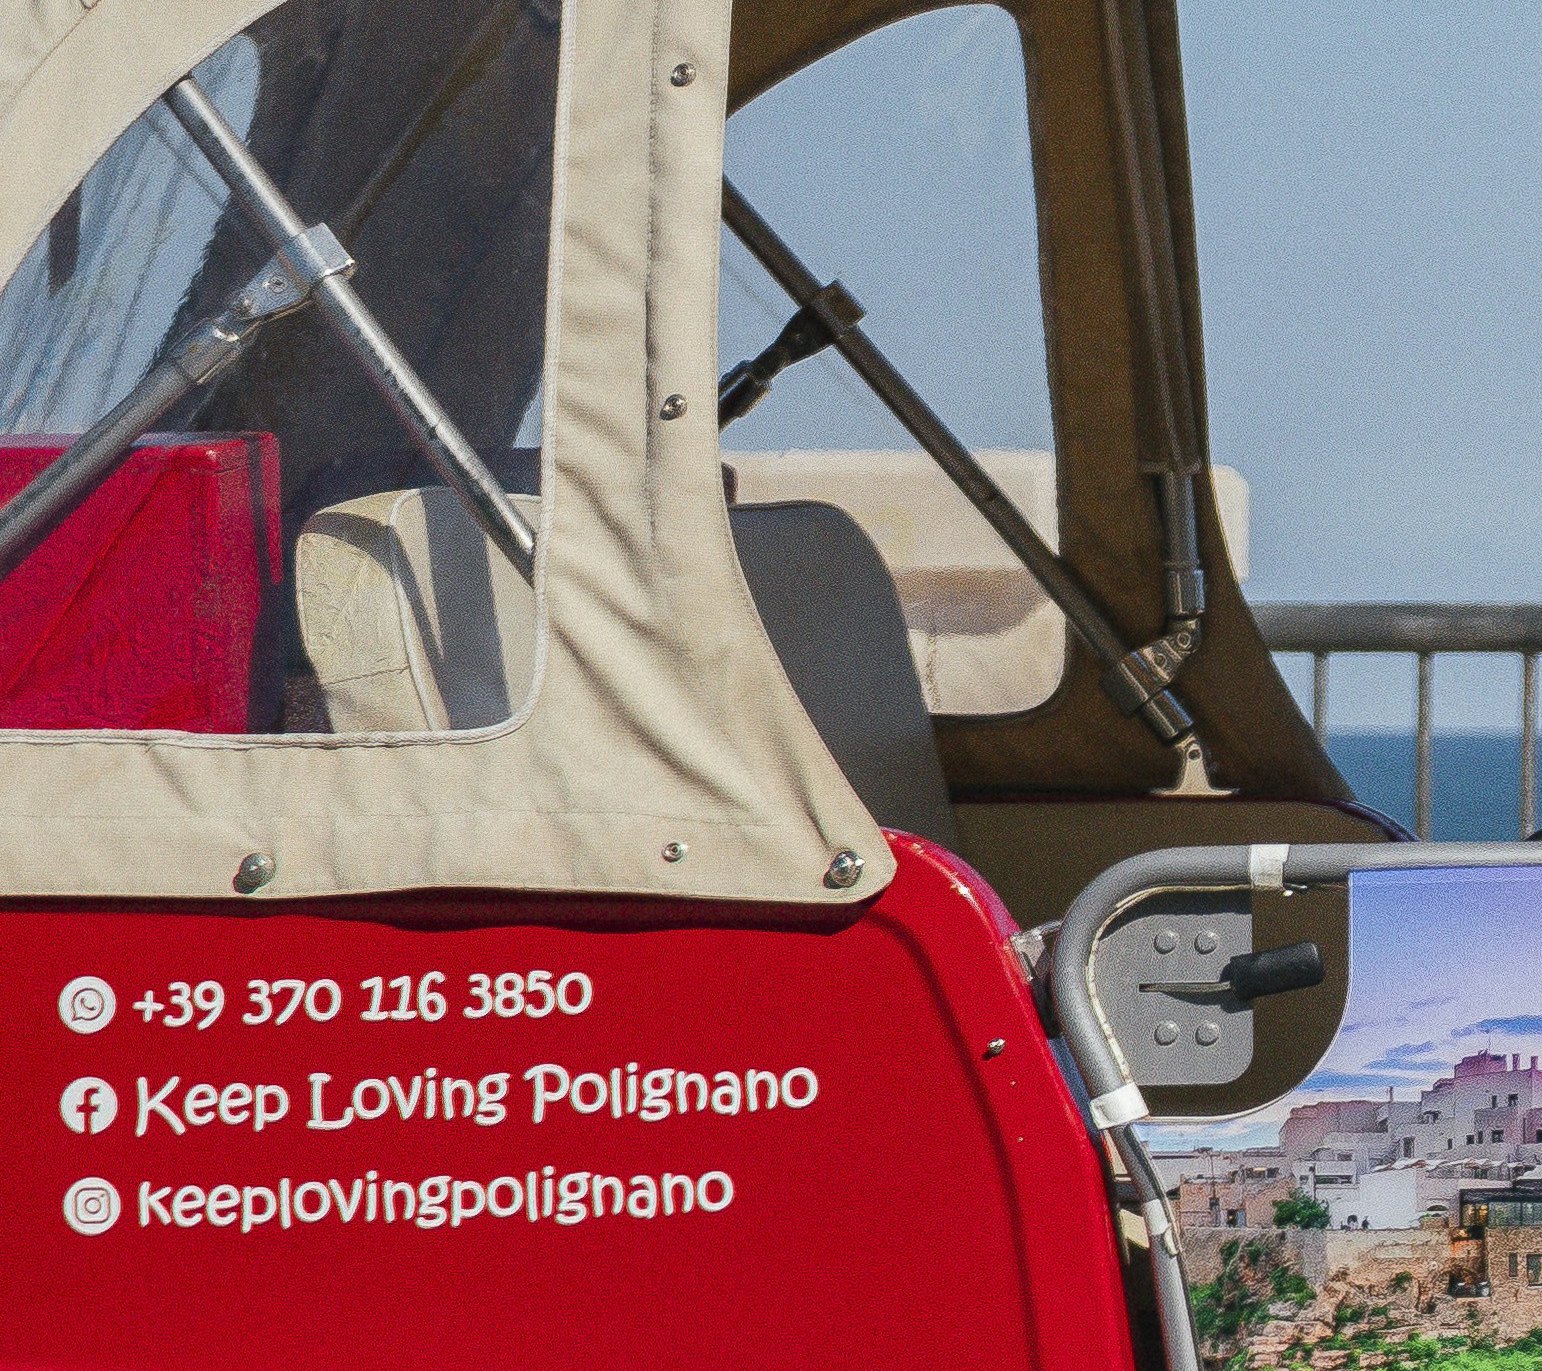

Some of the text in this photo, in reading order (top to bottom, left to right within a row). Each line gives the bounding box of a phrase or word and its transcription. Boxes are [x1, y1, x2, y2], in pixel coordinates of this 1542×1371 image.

[132, 969, 593, 1030] +39 370 116 3850
[135, 1062, 820, 1138] Keep Loving Polignano
[138, 1166, 735, 1234] keeplovingpolignano
